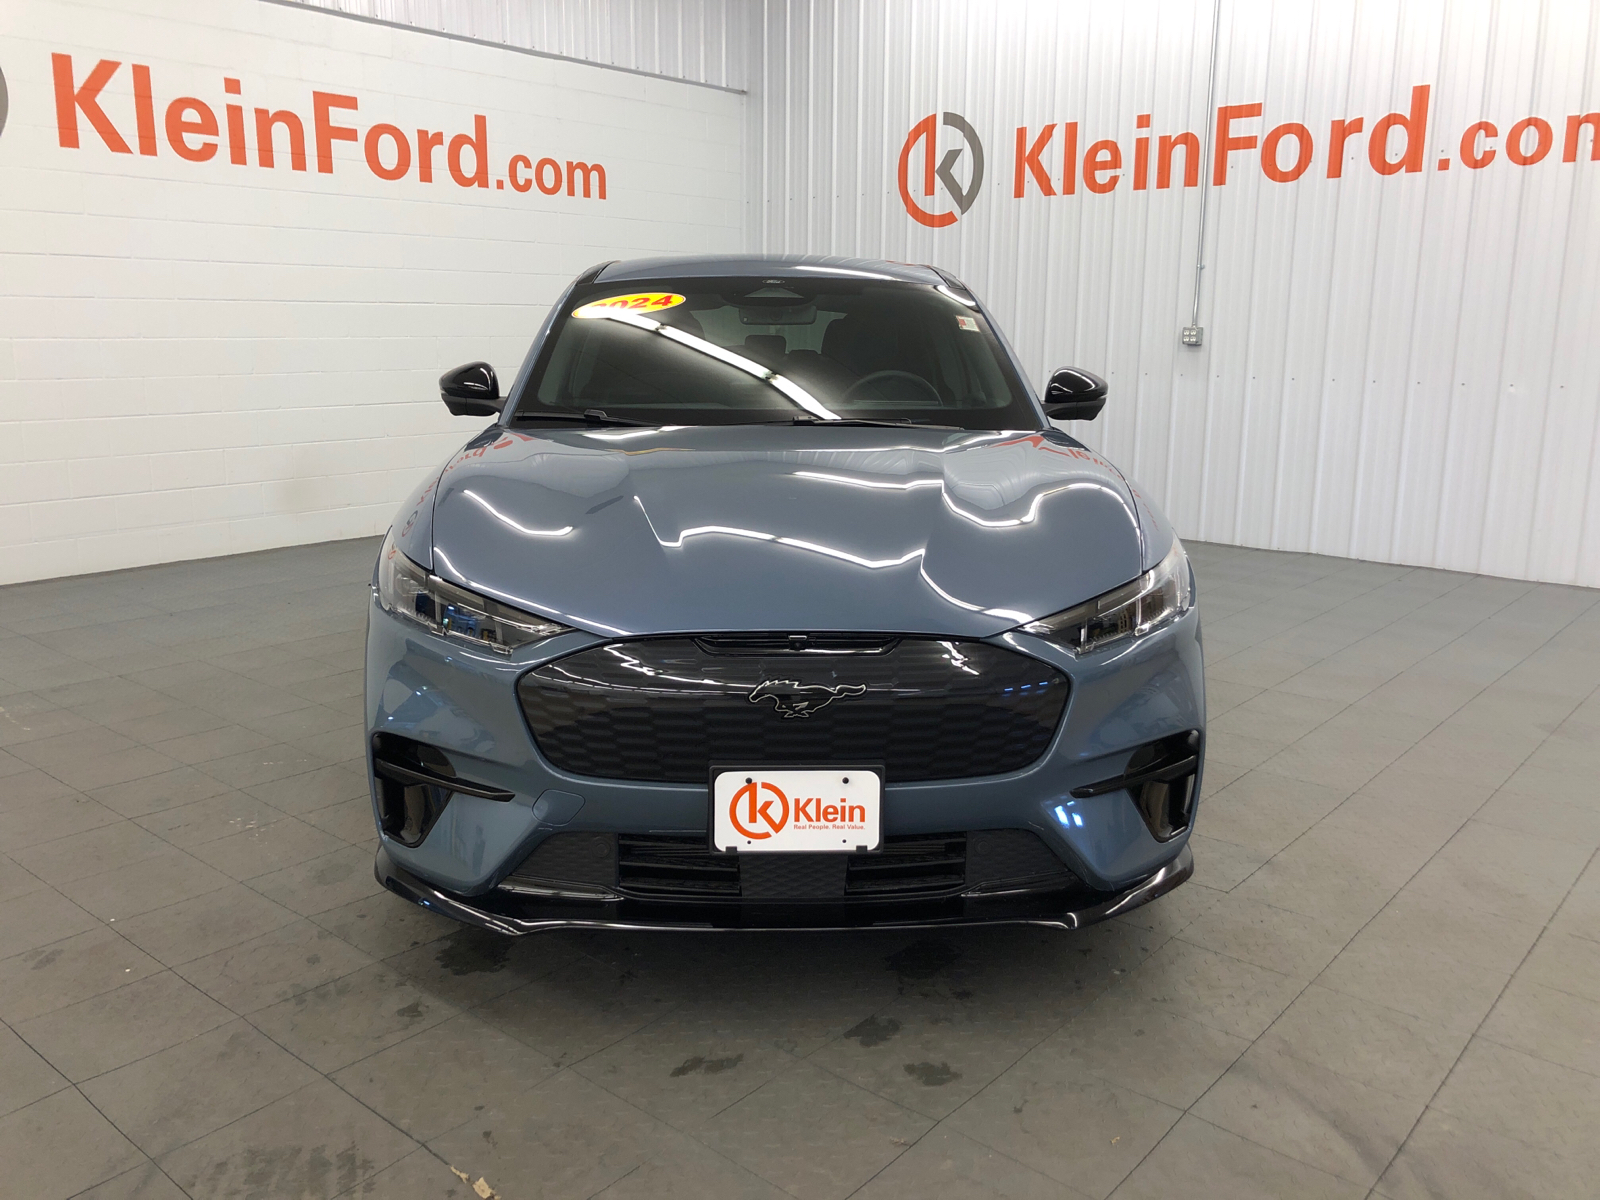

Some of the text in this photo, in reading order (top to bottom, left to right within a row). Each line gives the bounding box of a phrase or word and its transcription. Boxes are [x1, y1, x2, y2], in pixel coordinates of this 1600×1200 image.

[51, 53, 607, 200] KleinFord.com
[794, 797, 866, 823] Klein
[808, 823, 831, 831] People.
